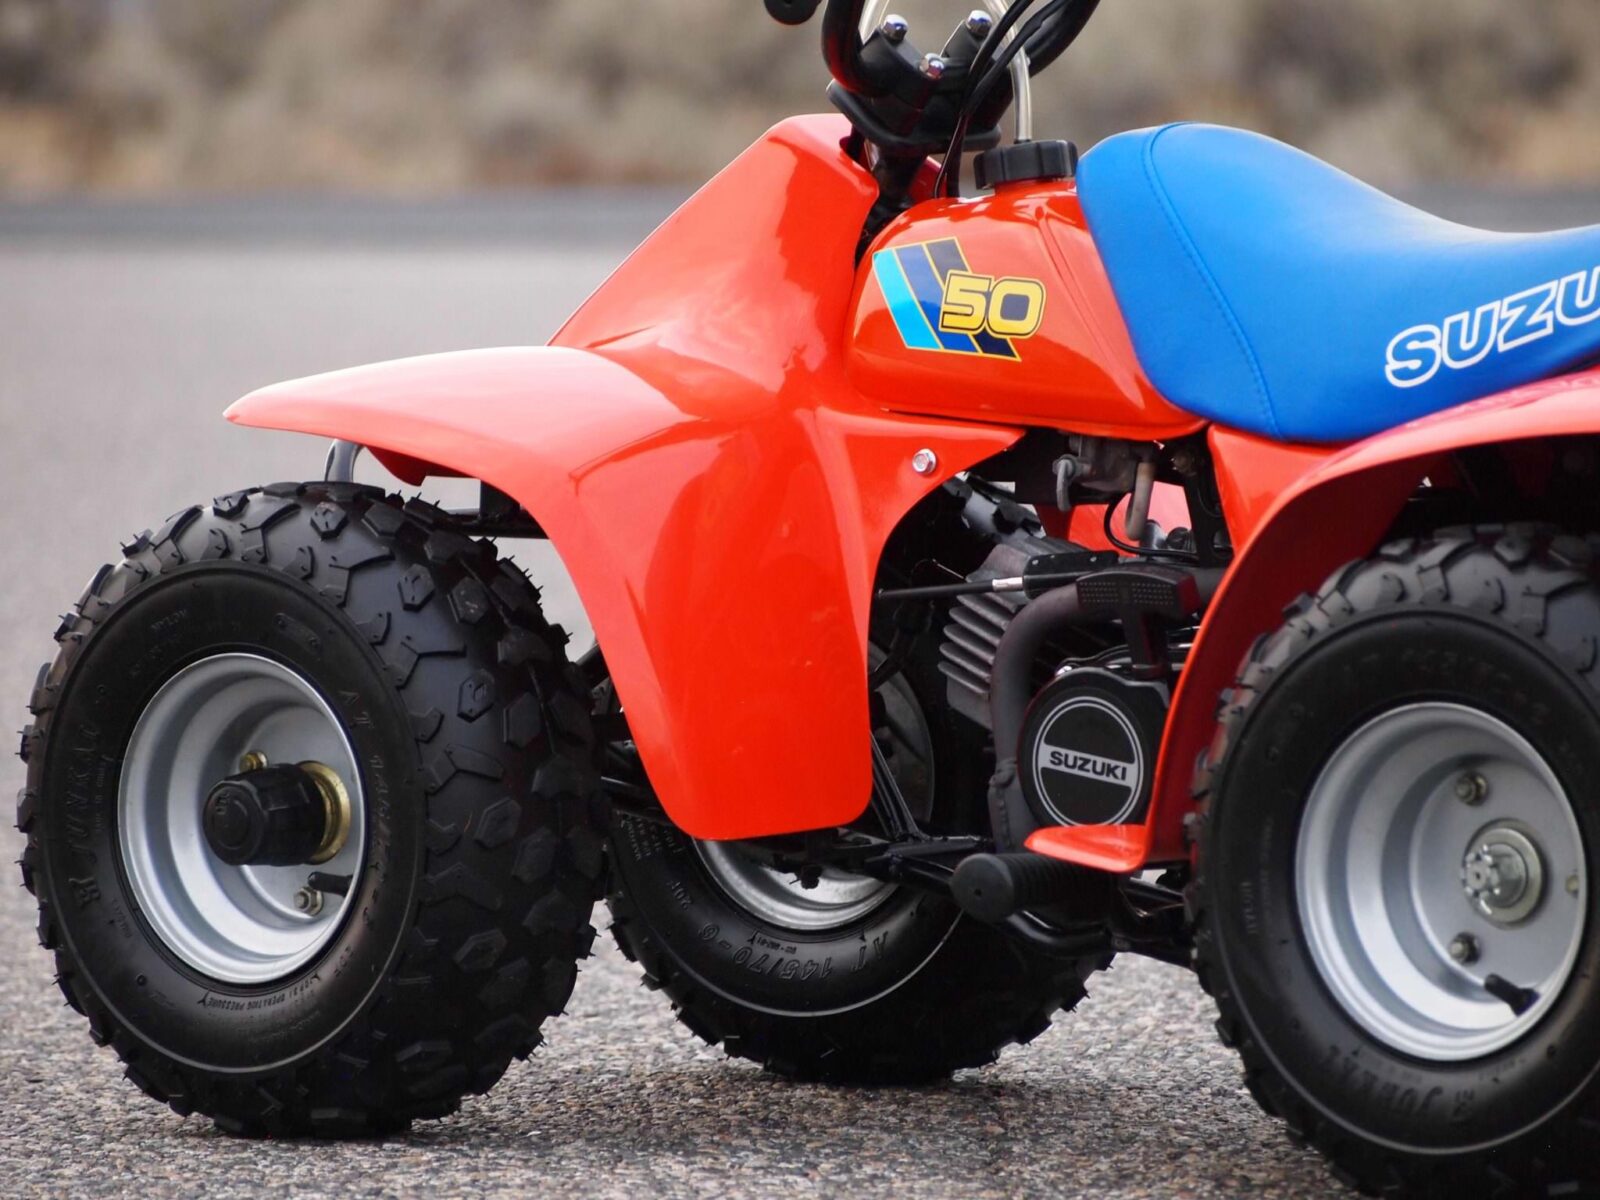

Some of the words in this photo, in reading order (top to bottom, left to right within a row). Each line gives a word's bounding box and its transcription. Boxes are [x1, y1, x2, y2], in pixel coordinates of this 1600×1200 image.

[939, 269, 1046, 339] 50
[1049, 750, 1127, 781] SUZUKI
[698, 922, 834, 981] 145/70-6
